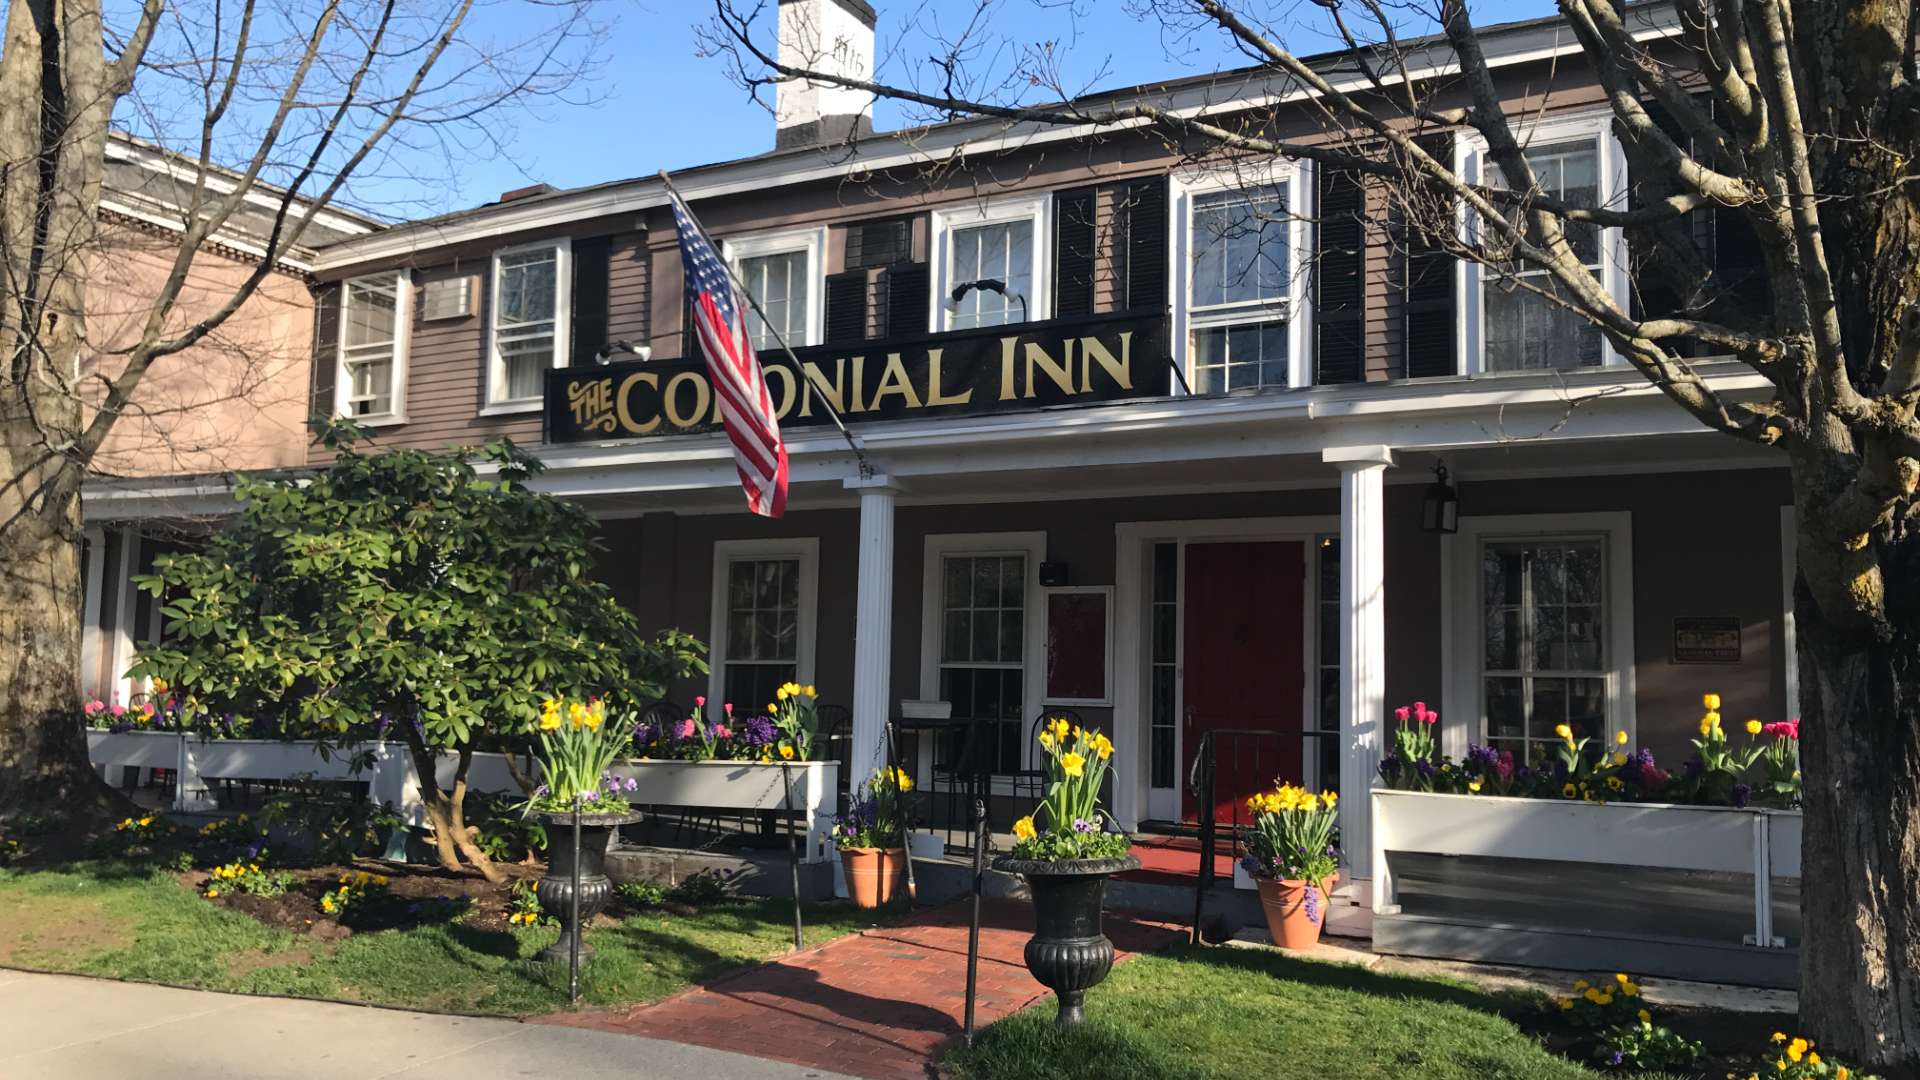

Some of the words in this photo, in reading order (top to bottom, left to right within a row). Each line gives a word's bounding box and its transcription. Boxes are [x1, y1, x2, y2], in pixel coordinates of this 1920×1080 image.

[568, 377, 616, 433] THE
[616, 348, 973, 433] COONIAL
[999, 331, 1134, 400] INN
